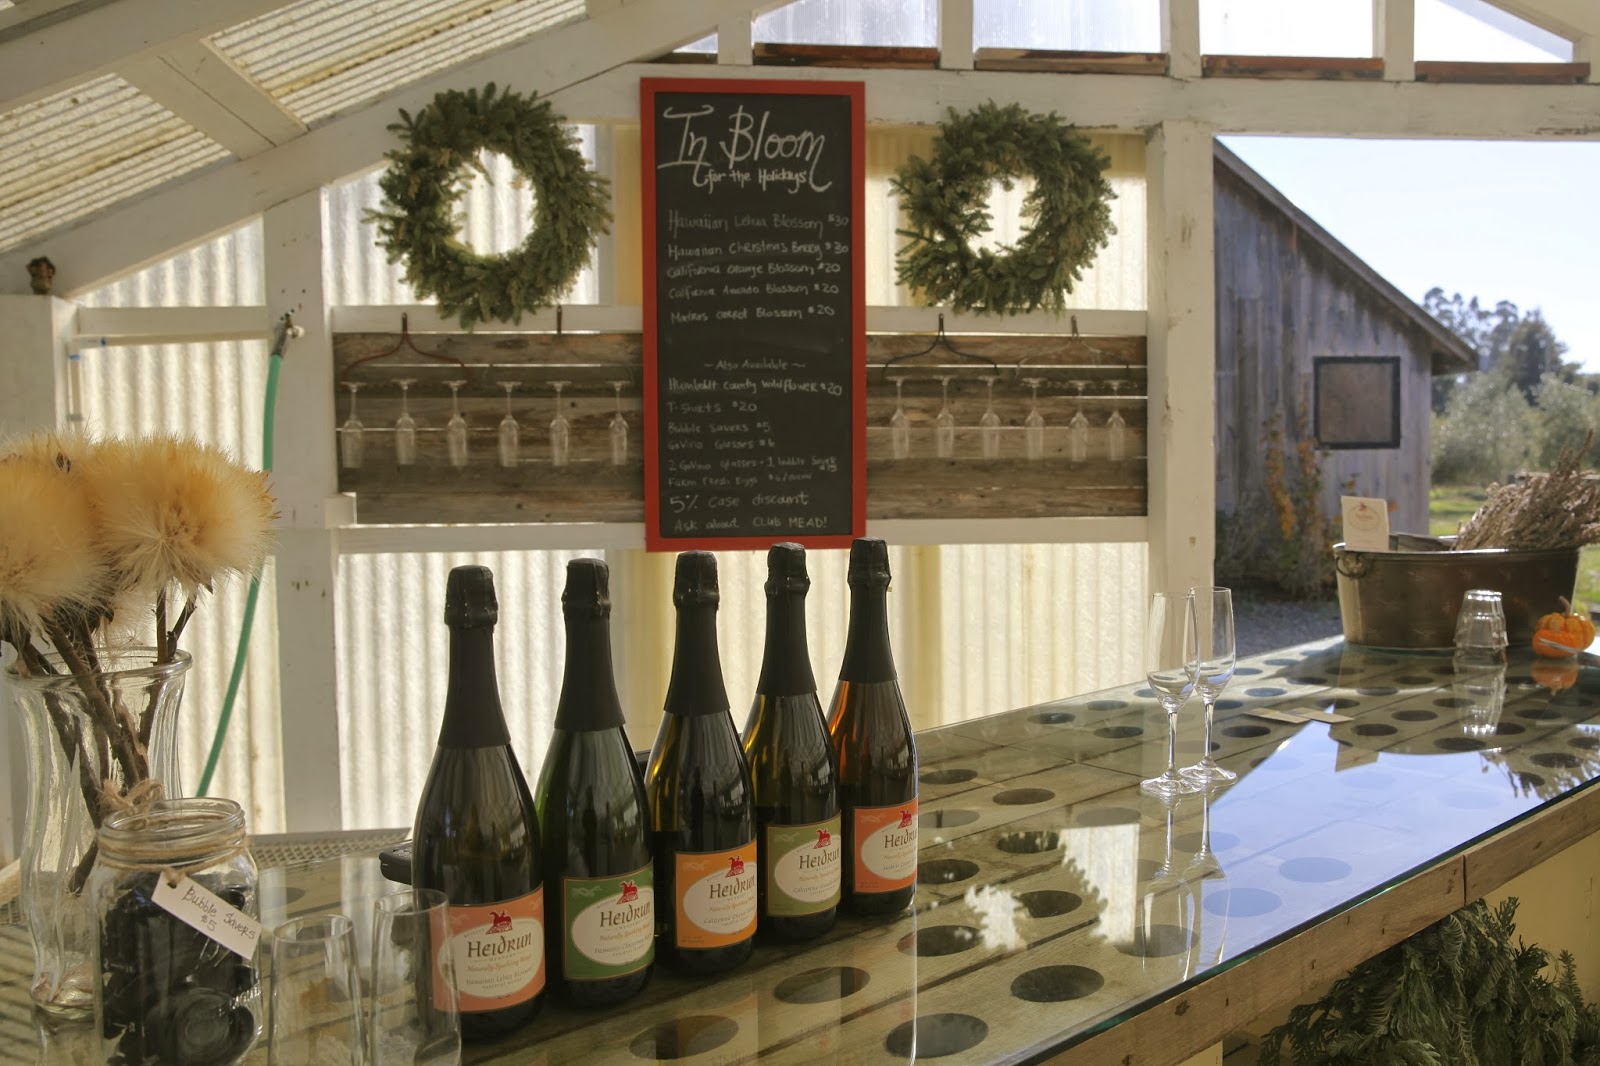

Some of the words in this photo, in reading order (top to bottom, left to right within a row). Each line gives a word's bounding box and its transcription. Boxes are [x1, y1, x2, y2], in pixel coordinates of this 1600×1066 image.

[657, 104, 714, 187] In
[719, 104, 832, 192] Bloom
[705, 169, 726, 194] for
[729, 170, 751, 188] the
[669, 209, 729, 239] Hawaiian
[772, 213, 823, 239] Blossom
[828, 214, 849, 226] $30
[668, 244, 722, 261] Hawaiian
[825, 241, 849, 254] $30
[667, 263, 720, 278] California
[768, 263, 814, 275] Blossom
[817, 262, 841, 273] $20
[766, 283, 809, 295] Blossom
[814, 283, 839, 294] $20
[756, 307, 802, 319] Blossom
[808, 305, 835, 316] $20
[821, 382, 842, 396] $20
[732, 401, 757, 412] $20
[670, 494, 699, 513] 5%
[705, 517, 740, 529] about
[788, 516, 827, 528] MEAD!
[182, 885, 218, 917] Bubble
[222, 912, 256, 940] Savers
[600, 901, 650, 928] Heidrun
[201, 914, 217, 932] $5
[467, 932, 531, 958] Heidrun
